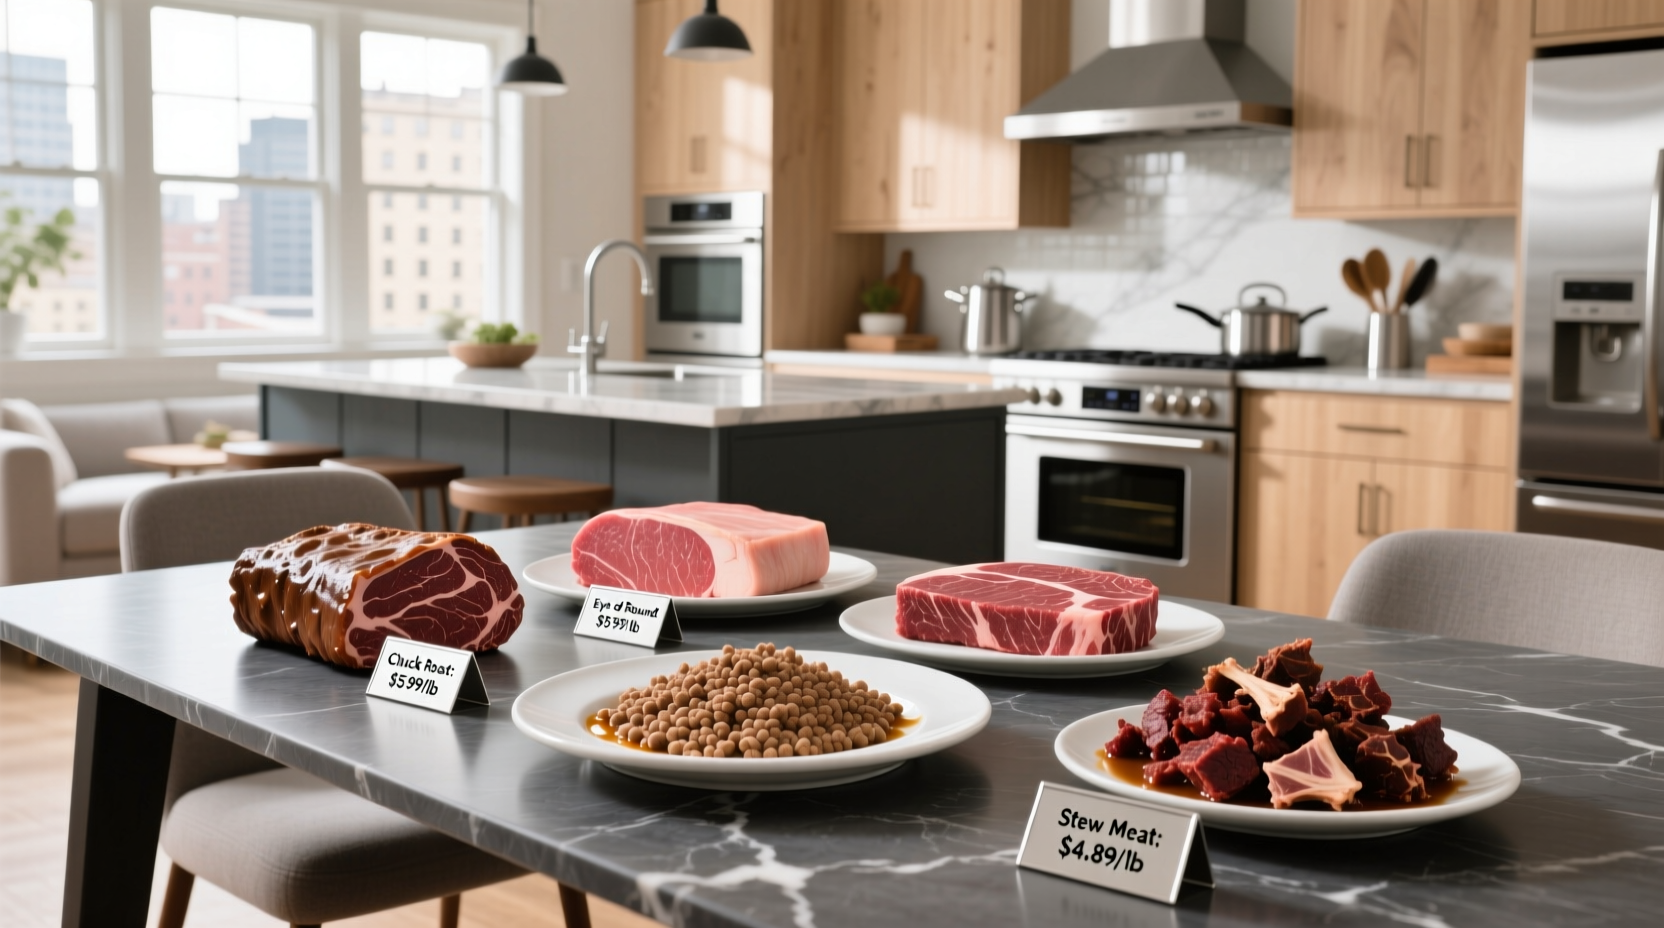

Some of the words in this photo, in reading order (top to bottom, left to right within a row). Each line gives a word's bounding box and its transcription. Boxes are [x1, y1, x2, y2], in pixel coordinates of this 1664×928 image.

[1058, 808, 1104, 833] Stew
[1108, 818, 1163, 848] Meat:
[1058, 834, 1144, 873] $4.89/lb
